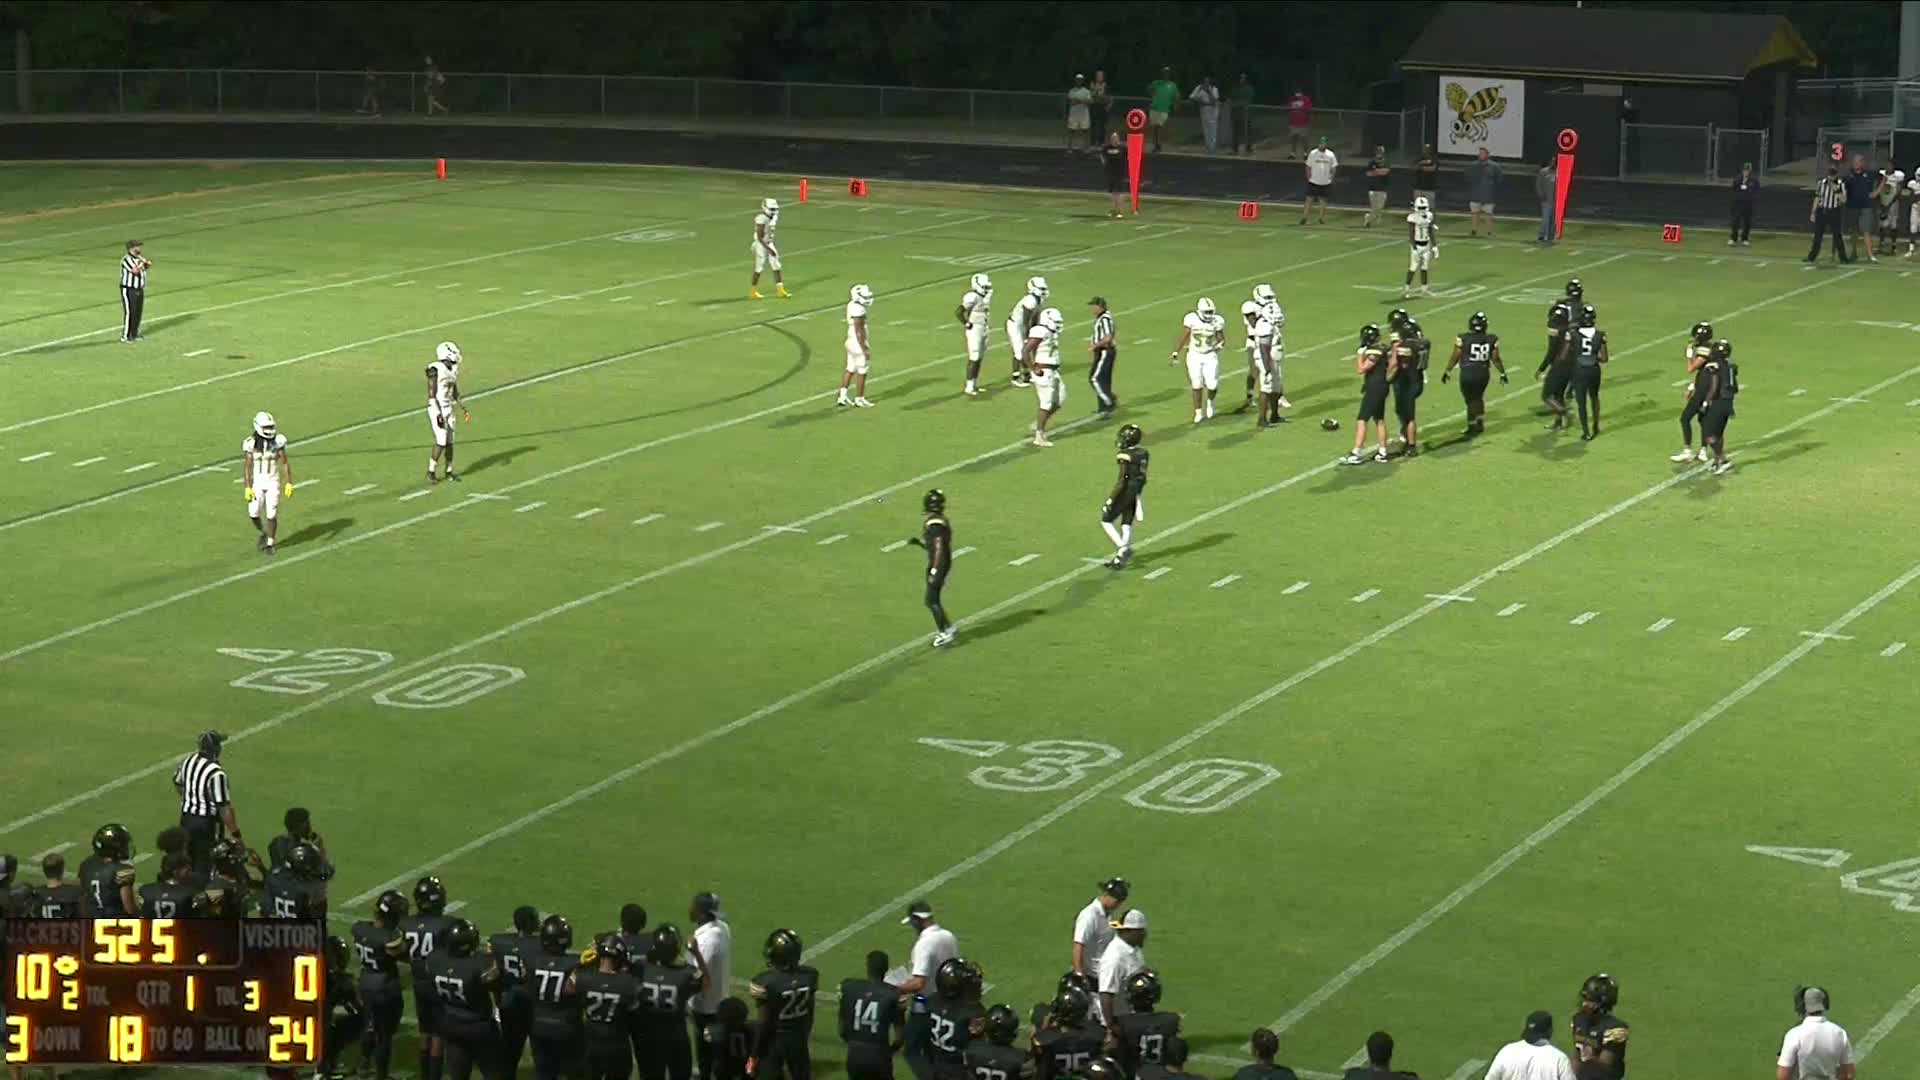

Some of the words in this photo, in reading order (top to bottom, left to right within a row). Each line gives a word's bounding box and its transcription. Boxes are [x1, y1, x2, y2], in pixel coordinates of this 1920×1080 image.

[1830, 143, 1843, 161] 3
[1663, 226, 1678, 241] 20
[1469, 343, 1491, 362] 58
[1581, 337, 1593, 356] 5
[228, 647, 526, 710] 20
[968, 738, 1282, 814] 30
[535, 968, 565, 1002] 77
[587, 990, 621, 1023] 27
[780, 986, 811, 1021] 22
[854, 998, 881, 1034] 14
[930, 1012, 957, 1052] 32
